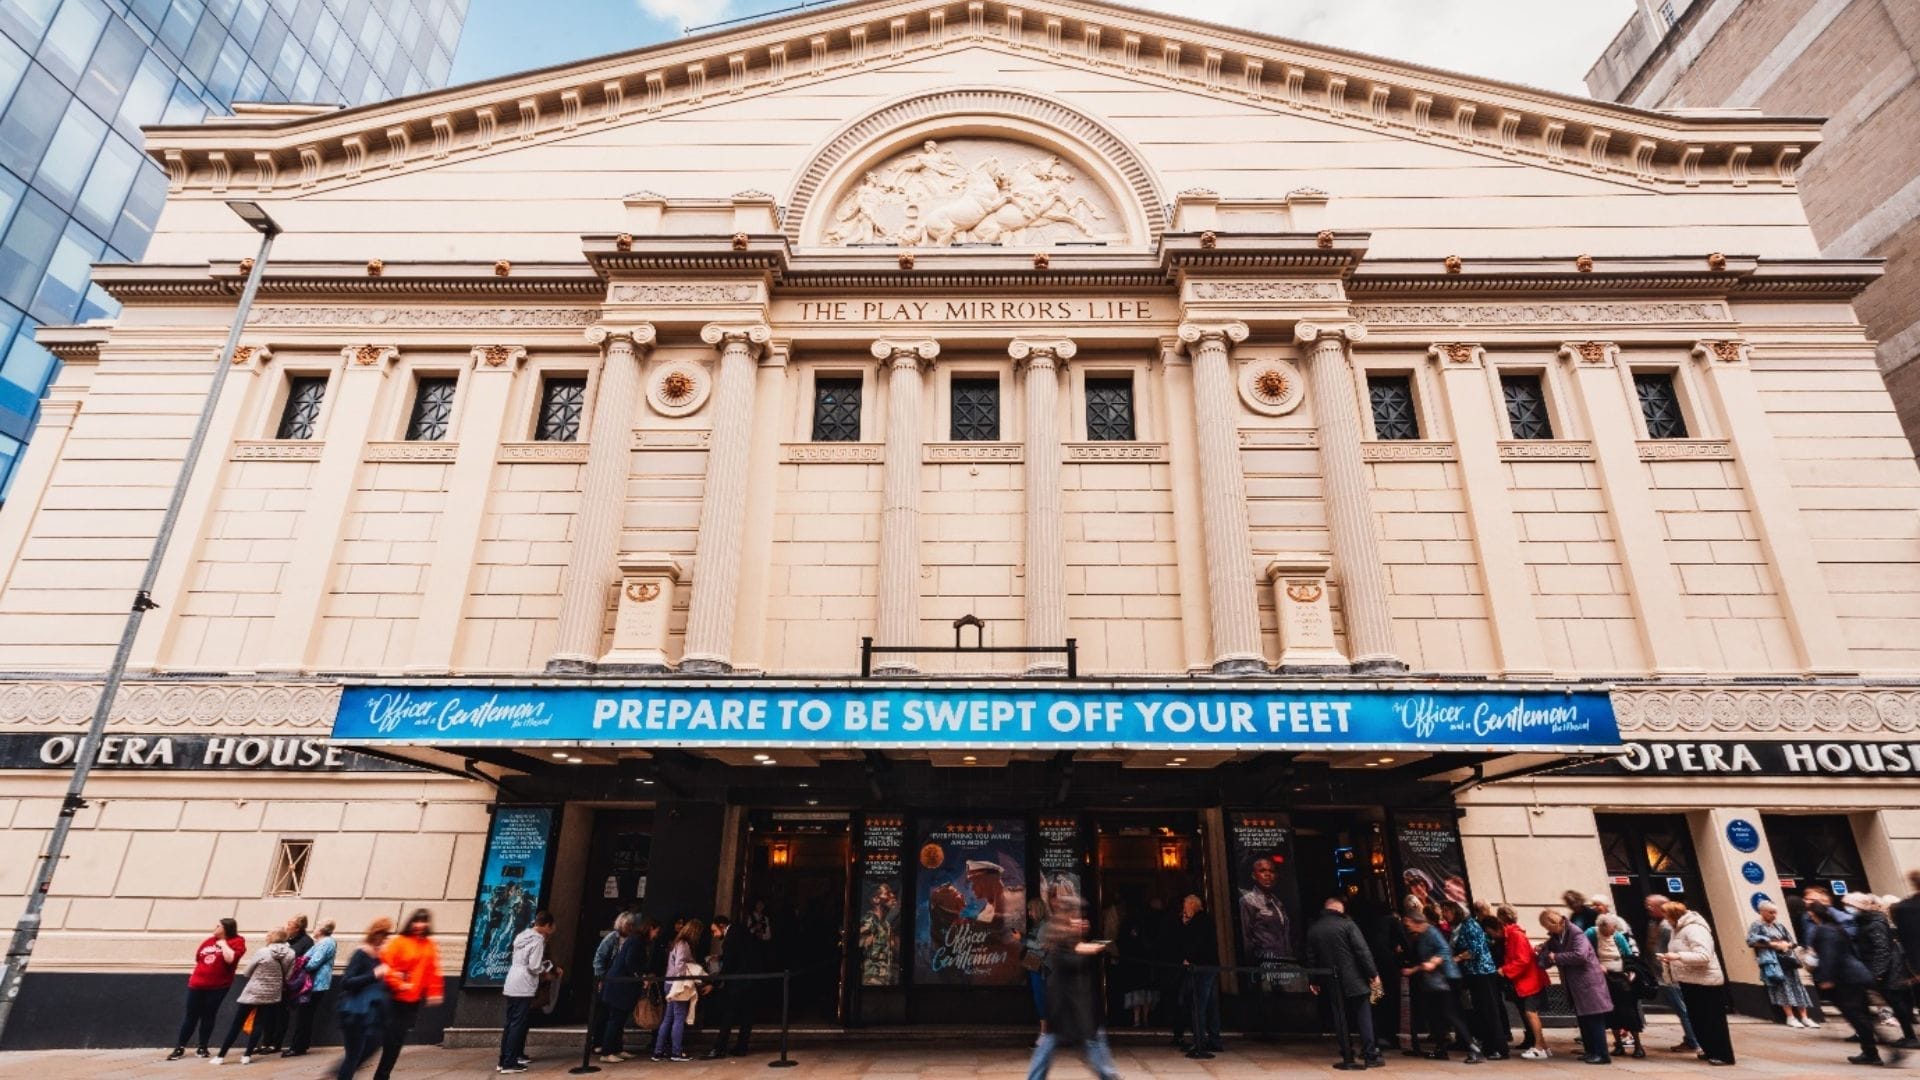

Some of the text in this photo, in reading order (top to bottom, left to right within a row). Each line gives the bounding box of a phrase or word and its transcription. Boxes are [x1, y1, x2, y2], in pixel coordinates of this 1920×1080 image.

[798, 301, 1153, 320] THE PLAY MIRRORS LIFE
[370, 692, 438, 733] Officer
[437, 694, 545, 731] Gentleman
[592, 699, 1352, 732] PREPARE TO BE SWEPT OFF YOUR FEET
[1402, 697, 1465, 738] Officer
[1473, 698, 1577, 737] Gentleman
[202, 737, 344, 766] HOUSE
[1616, 742, 1762, 771] OPERA
[944, 923, 991, 954] Officer
[932, 945, 1007, 972] Gentleman
